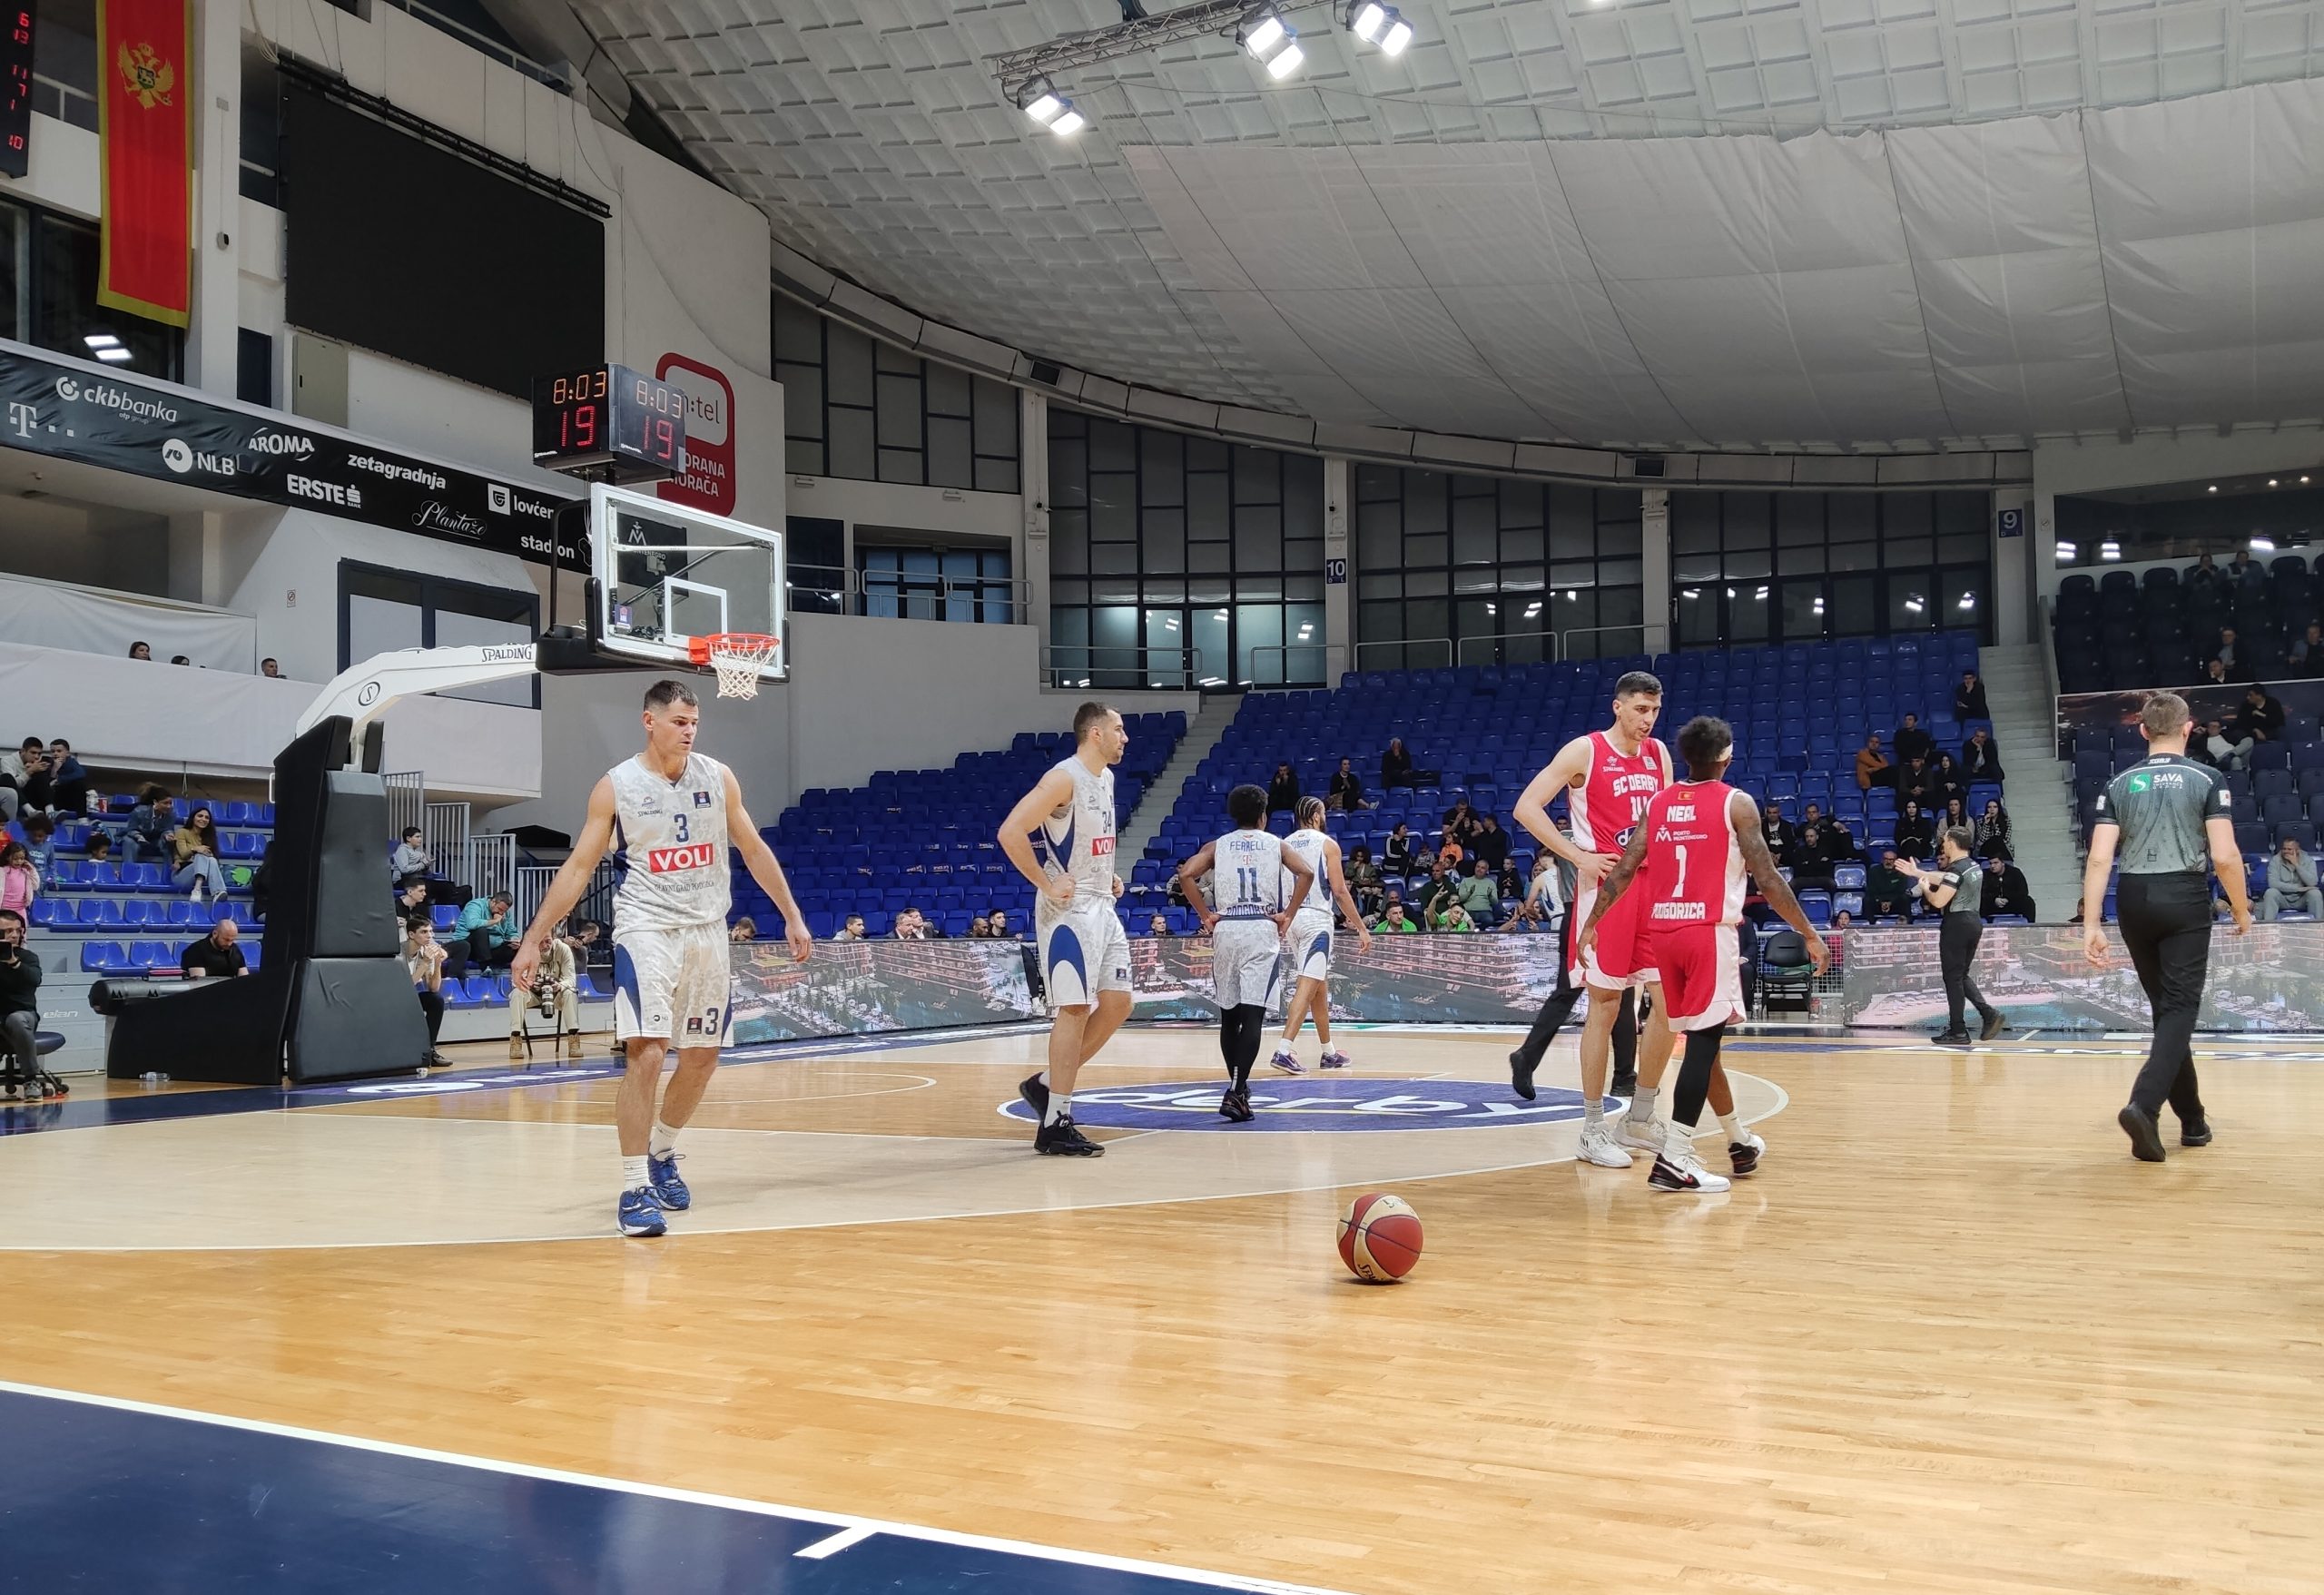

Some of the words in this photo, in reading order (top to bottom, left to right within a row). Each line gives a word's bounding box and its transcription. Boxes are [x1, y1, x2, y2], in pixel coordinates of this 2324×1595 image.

[553, 370, 606, 405] 8:03
[636, 379, 681, 419] 8:03
[84, 385, 178, 423] ckbbanka
[561, 406, 596, 447] 19
[644, 415, 674, 460] 19
[248, 434, 315, 455] AROMA
[197, 452, 235, 476] NLB
[348, 454, 447, 490] zetagradnja
[684, 452, 725, 478] ORANA
[287, 473, 345, 506] ERSTE
[674, 474, 719, 497] ORAČA
[411, 500, 487, 537] Plantaže
[2004, 511, 2017, 529] 9
[520, 535, 575, 559] stadon
[634, 549, 665, 560] NTENEGRO
[1327, 561, 1345, 576] 10
[482, 645, 532, 663] SPALDING
[1627, 773, 1659, 793] DERBY
[2153, 773, 2183, 783] SAVA
[1667, 805, 1697, 822] NEAL
[674, 813, 689, 842] 3
[655, 846, 709, 871] VOLI
[1229, 841, 1266, 852] FERRELL
[1671, 845, 1687, 898] 1
[1237, 868, 1262, 903] 11
[43, 1009, 79, 1018] elan
[705, 1008, 718, 1035] 3
